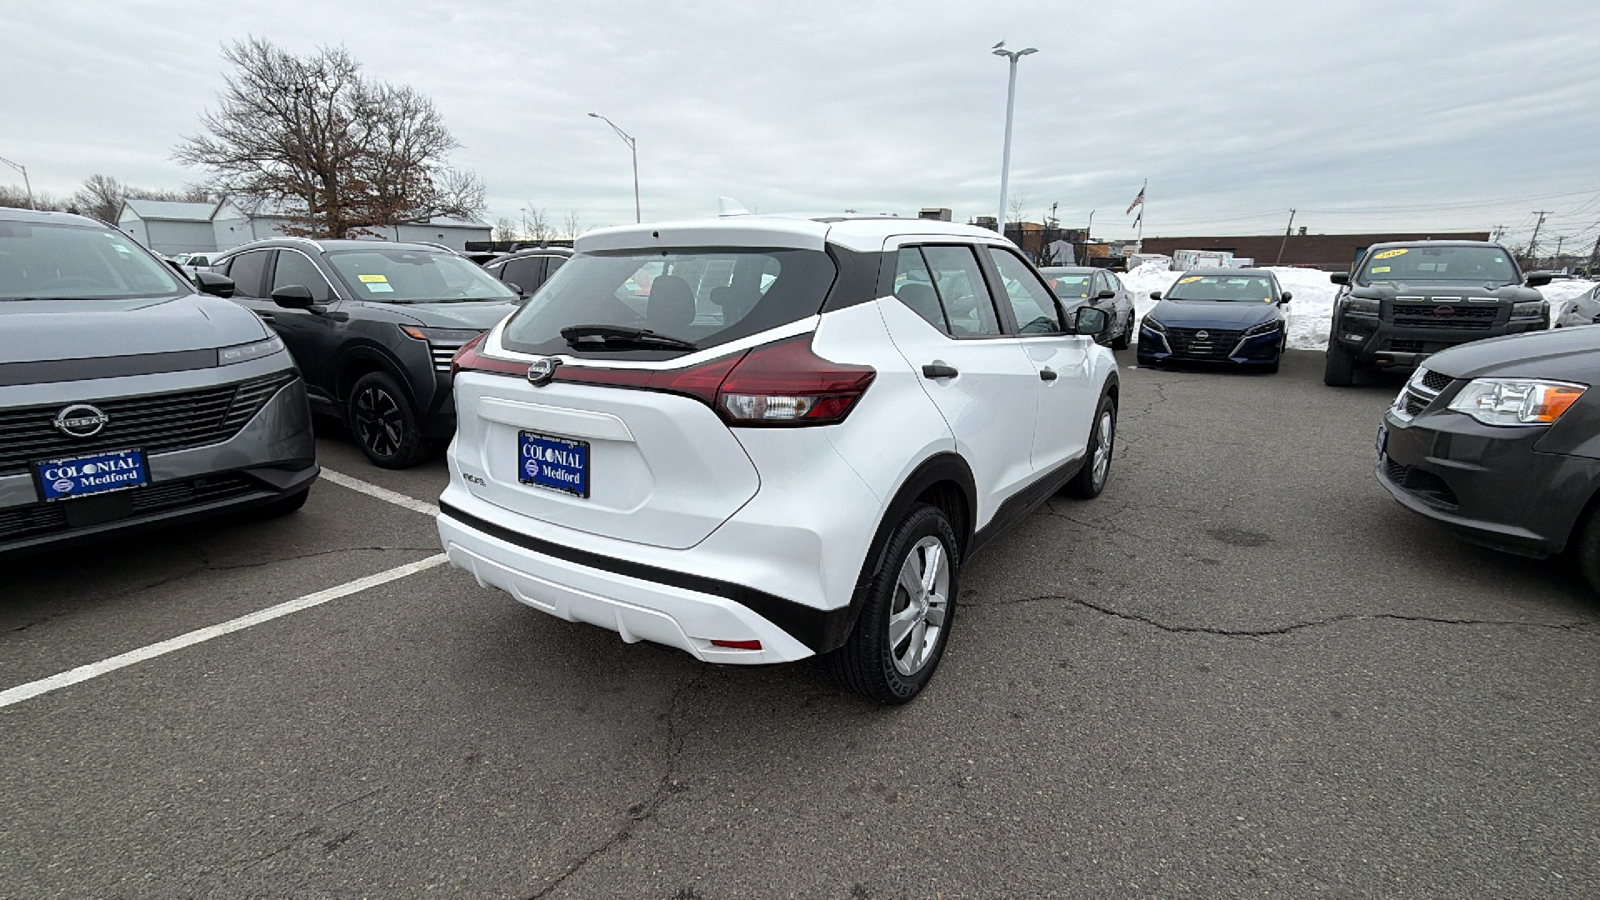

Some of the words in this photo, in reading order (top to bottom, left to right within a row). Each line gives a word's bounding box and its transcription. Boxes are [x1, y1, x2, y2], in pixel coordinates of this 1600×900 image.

[54, 415, 109, 428] NISSAN
[80, 470, 138, 487] Medford
[542, 465, 580, 484] Medford
